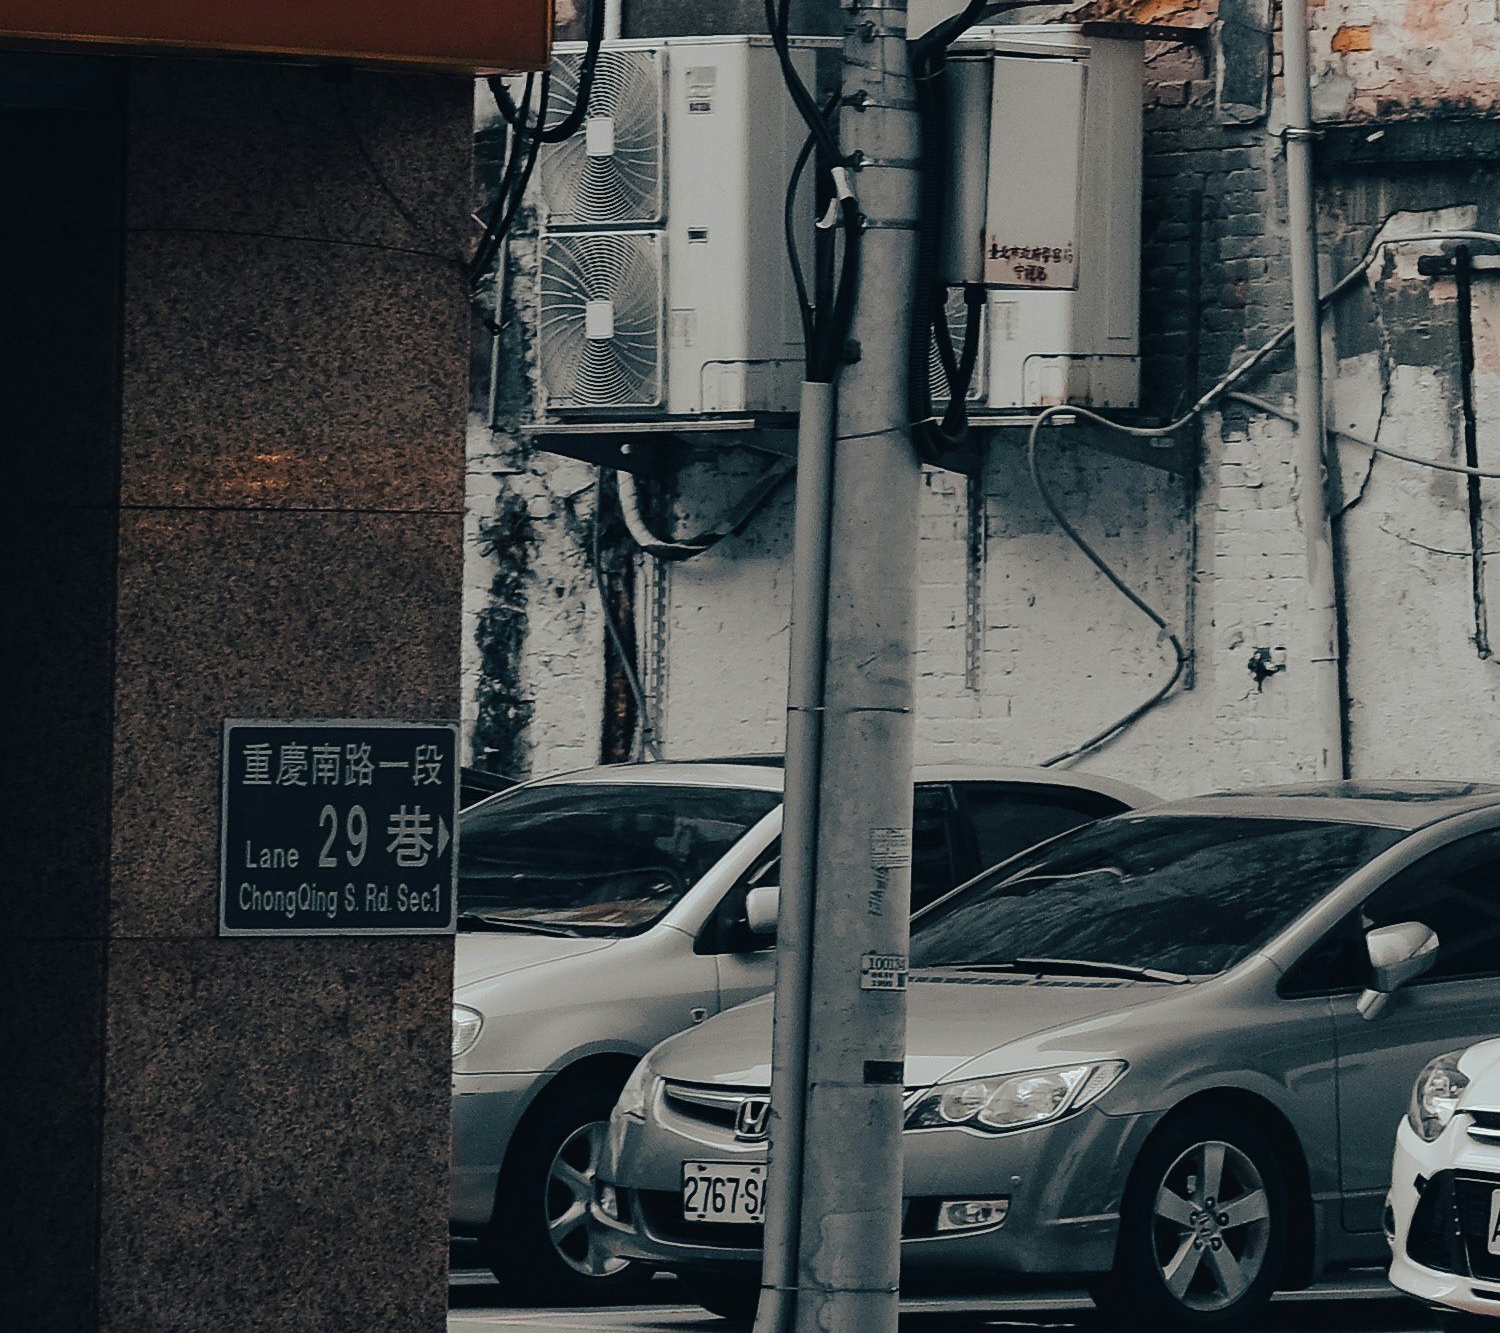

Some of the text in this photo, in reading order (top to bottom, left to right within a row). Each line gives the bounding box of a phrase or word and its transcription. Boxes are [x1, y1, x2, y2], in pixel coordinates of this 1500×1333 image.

[241, 742, 444, 787] 重慶南路一段
[245, 804, 434, 869] Lane 29 巷
[239, 882, 338, 918] ChongQing
[344, 883, 360, 911] S.
[365, 884, 392, 912] Rd.
